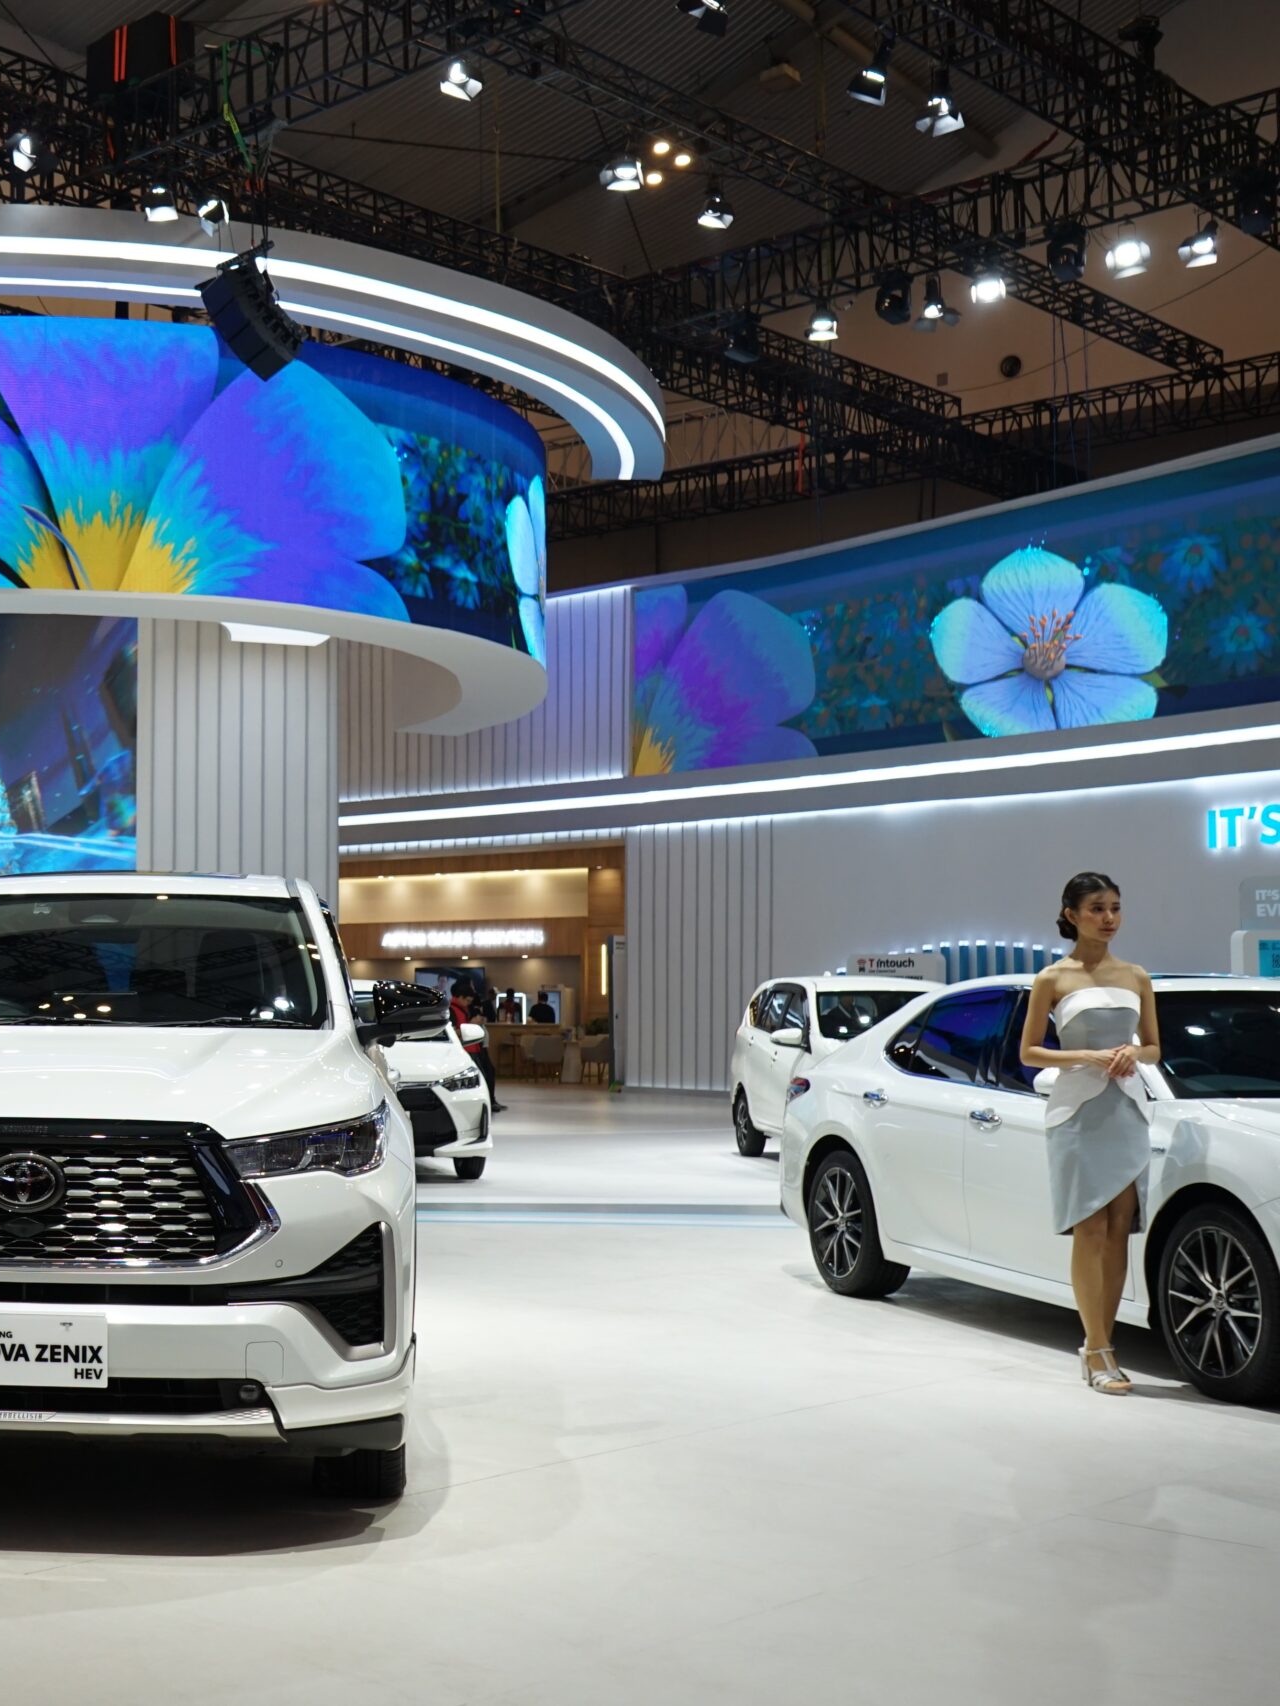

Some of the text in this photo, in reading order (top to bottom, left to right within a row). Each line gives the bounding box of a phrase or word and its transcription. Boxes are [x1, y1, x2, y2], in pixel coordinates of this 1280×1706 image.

[1206, 804, 1280, 849] IT'S
[868, 959, 875, 968] T
[35, 1344, 103, 1364] ZENIX
[74, 1368, 103, 1380] HEV
